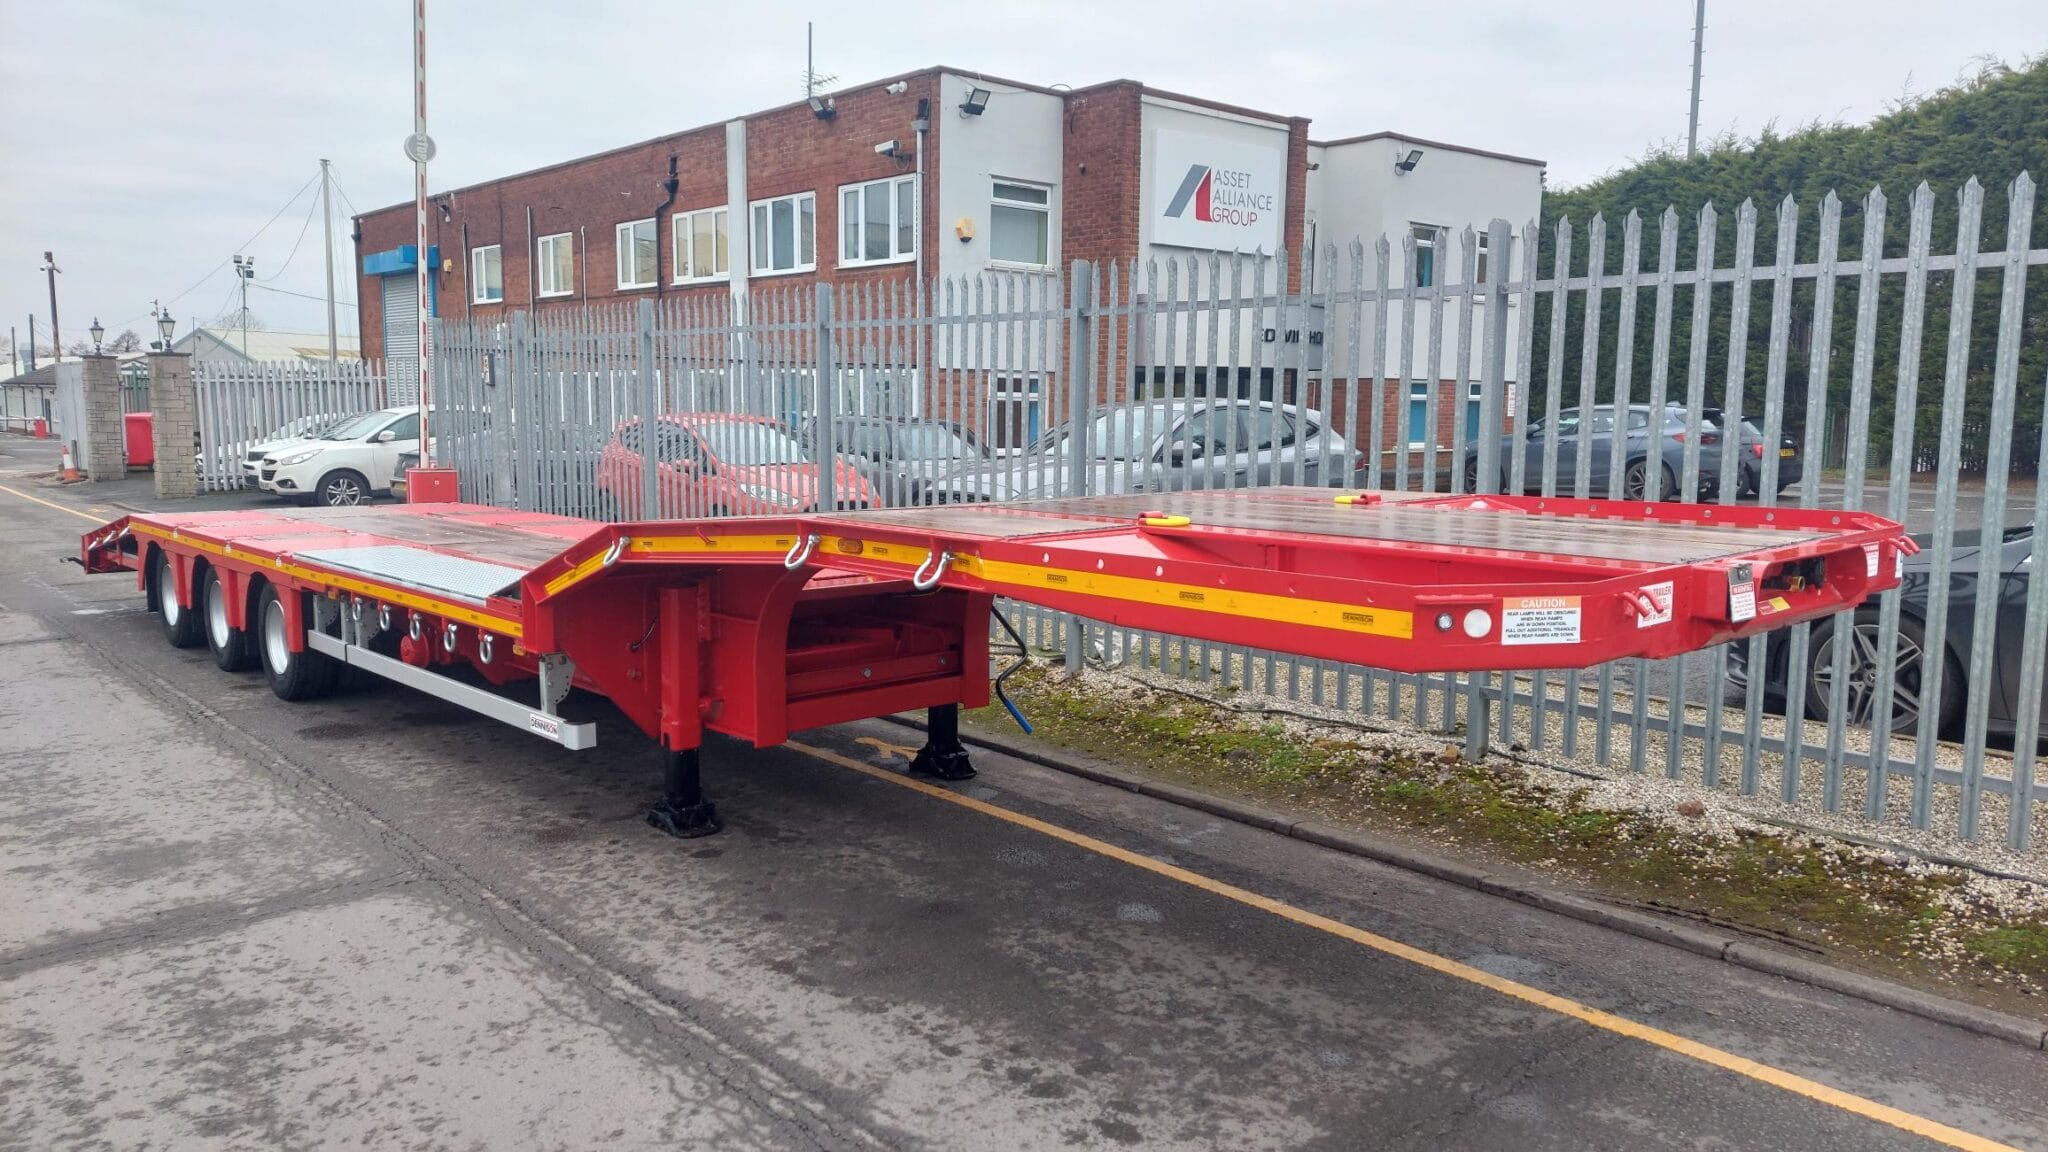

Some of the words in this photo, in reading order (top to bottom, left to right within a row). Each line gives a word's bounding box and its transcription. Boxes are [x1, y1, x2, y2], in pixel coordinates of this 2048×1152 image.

[1213, 169, 1251, 188] ASSET
[1212, 189, 1272, 211] ALLIANCE
[1212, 207, 1257, 226] GROUP
[1521, 599, 1566, 608] CAUTION
[1343, 613, 1373, 623] DENNISON
[531, 718, 558, 734] DENNISON
